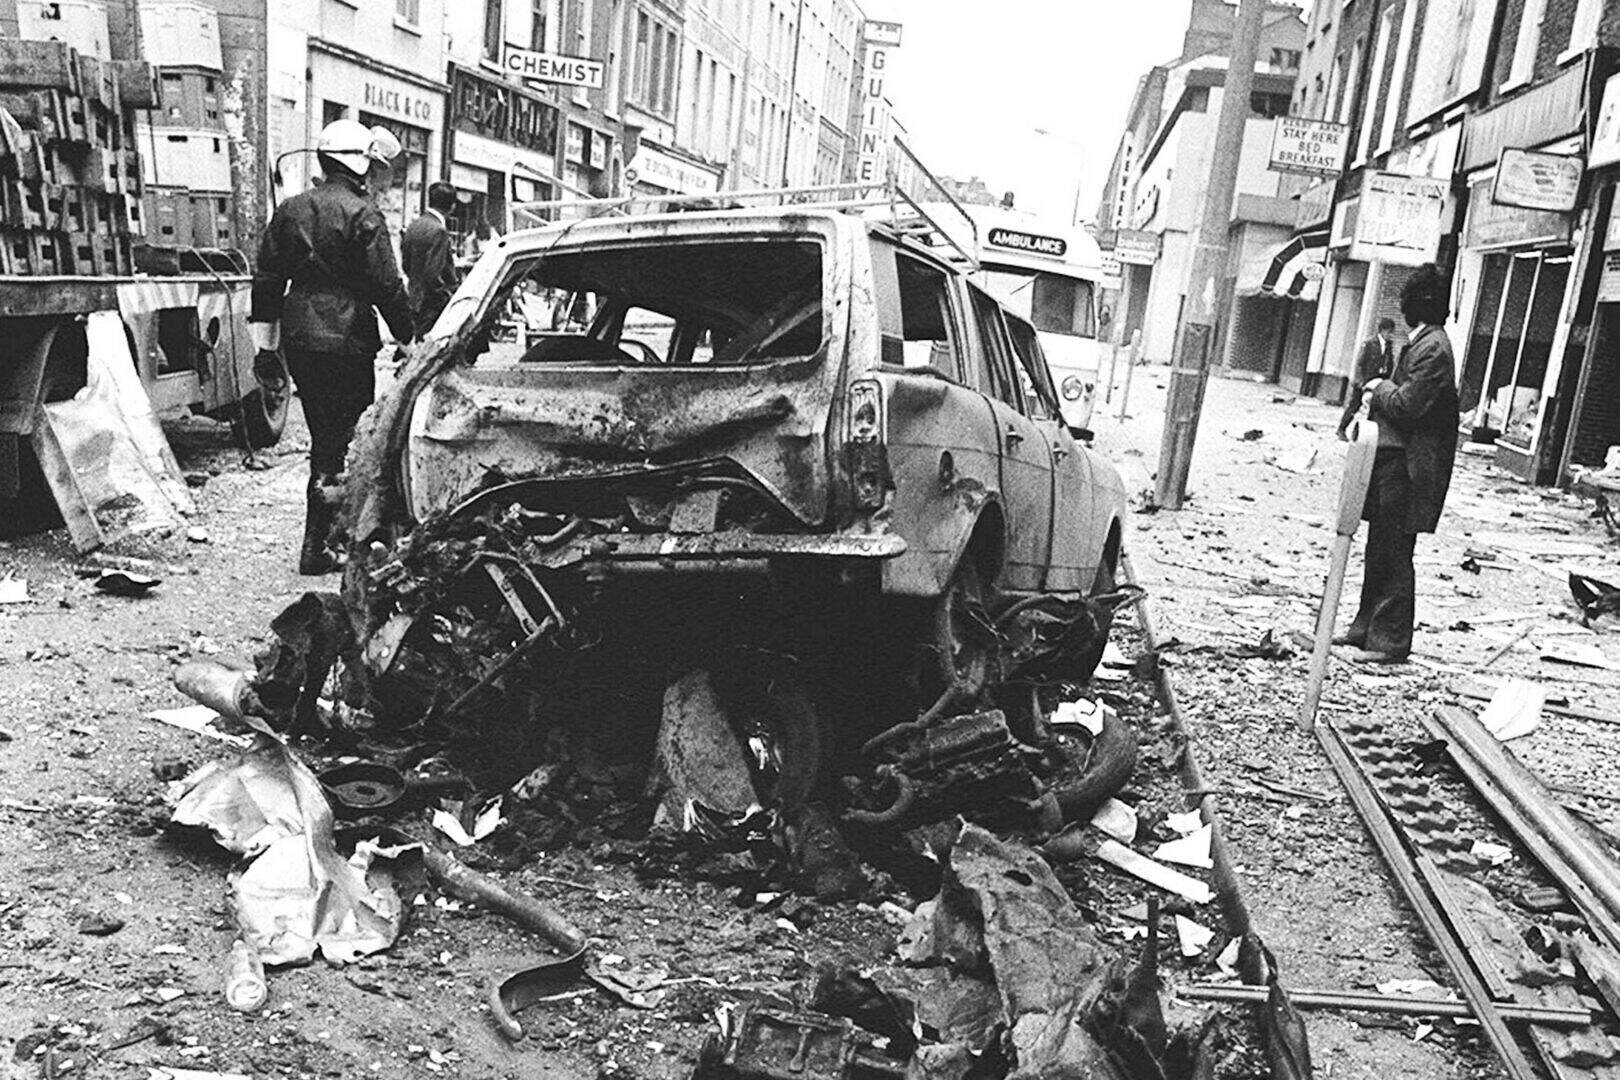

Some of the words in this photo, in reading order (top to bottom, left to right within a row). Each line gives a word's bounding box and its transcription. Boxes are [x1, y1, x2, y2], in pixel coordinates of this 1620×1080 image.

[508, 54, 600, 84] CHEMIST
[364, 82, 399, 112] BLACK
[1283, 127, 1308, 140] STAY
[1311, 131, 1340, 145] HERE
[1298, 141, 1321, 155] BED
[1279, 150, 1337, 168] BREAKFAST
[992, 230, 1063, 254] AMBULANCE
